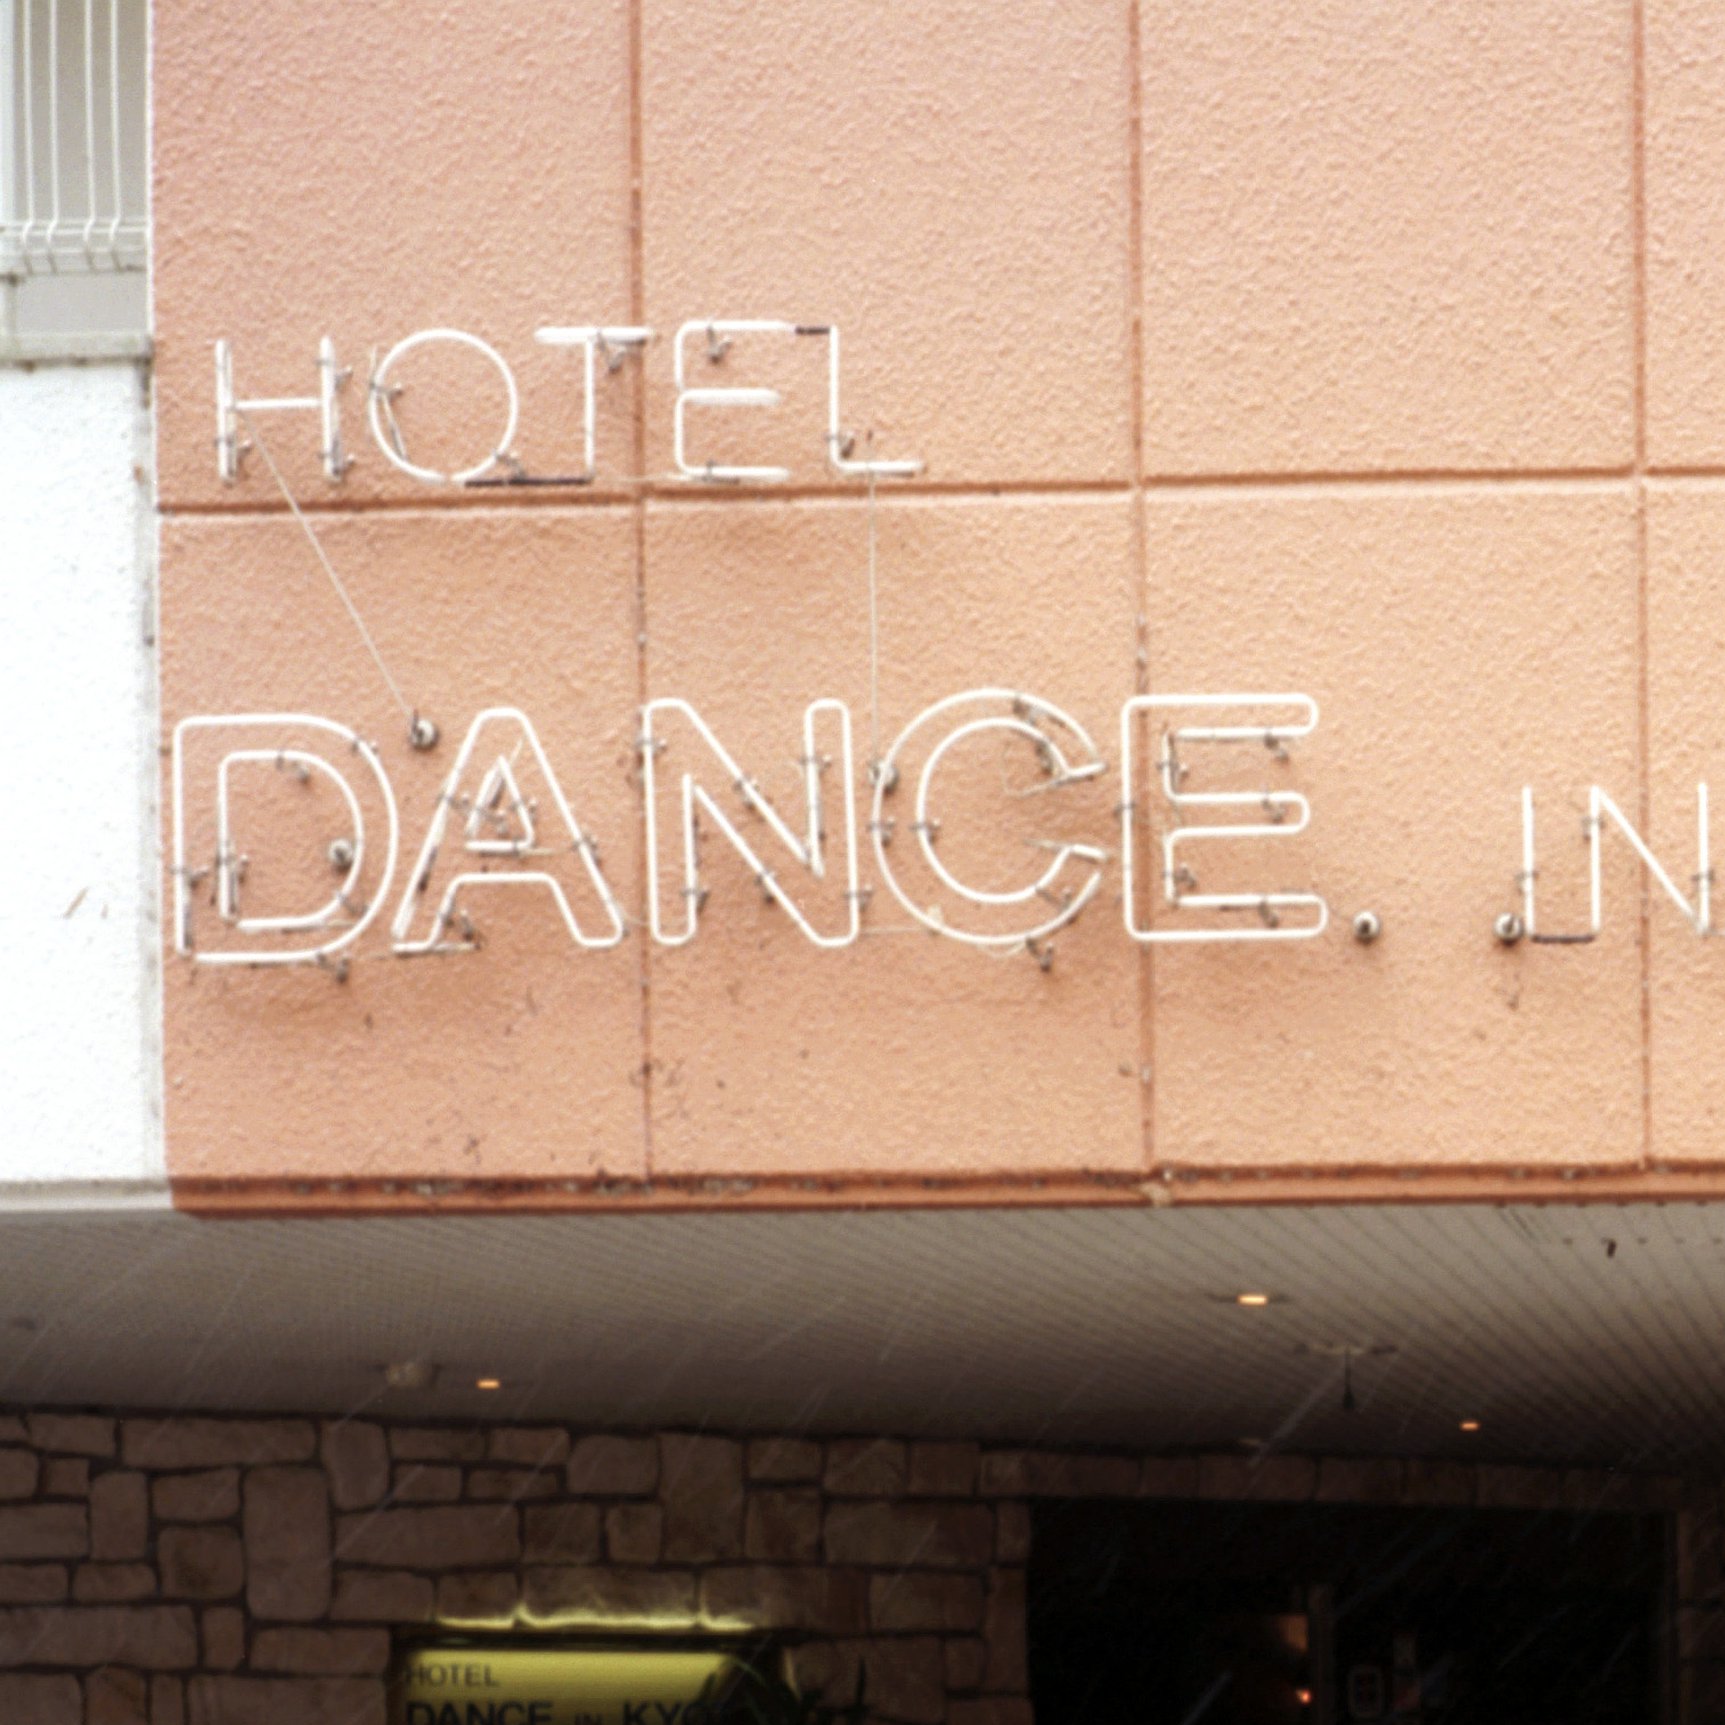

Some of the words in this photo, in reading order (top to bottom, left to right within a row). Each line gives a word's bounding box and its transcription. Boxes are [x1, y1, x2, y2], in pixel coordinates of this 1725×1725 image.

[215, 319, 925, 486] HOTEL
[171, 686, 1329, 966] DANCE
[1520, 782, 1714, 942] IN
[405, 1663, 500, 1687] HOTEL
